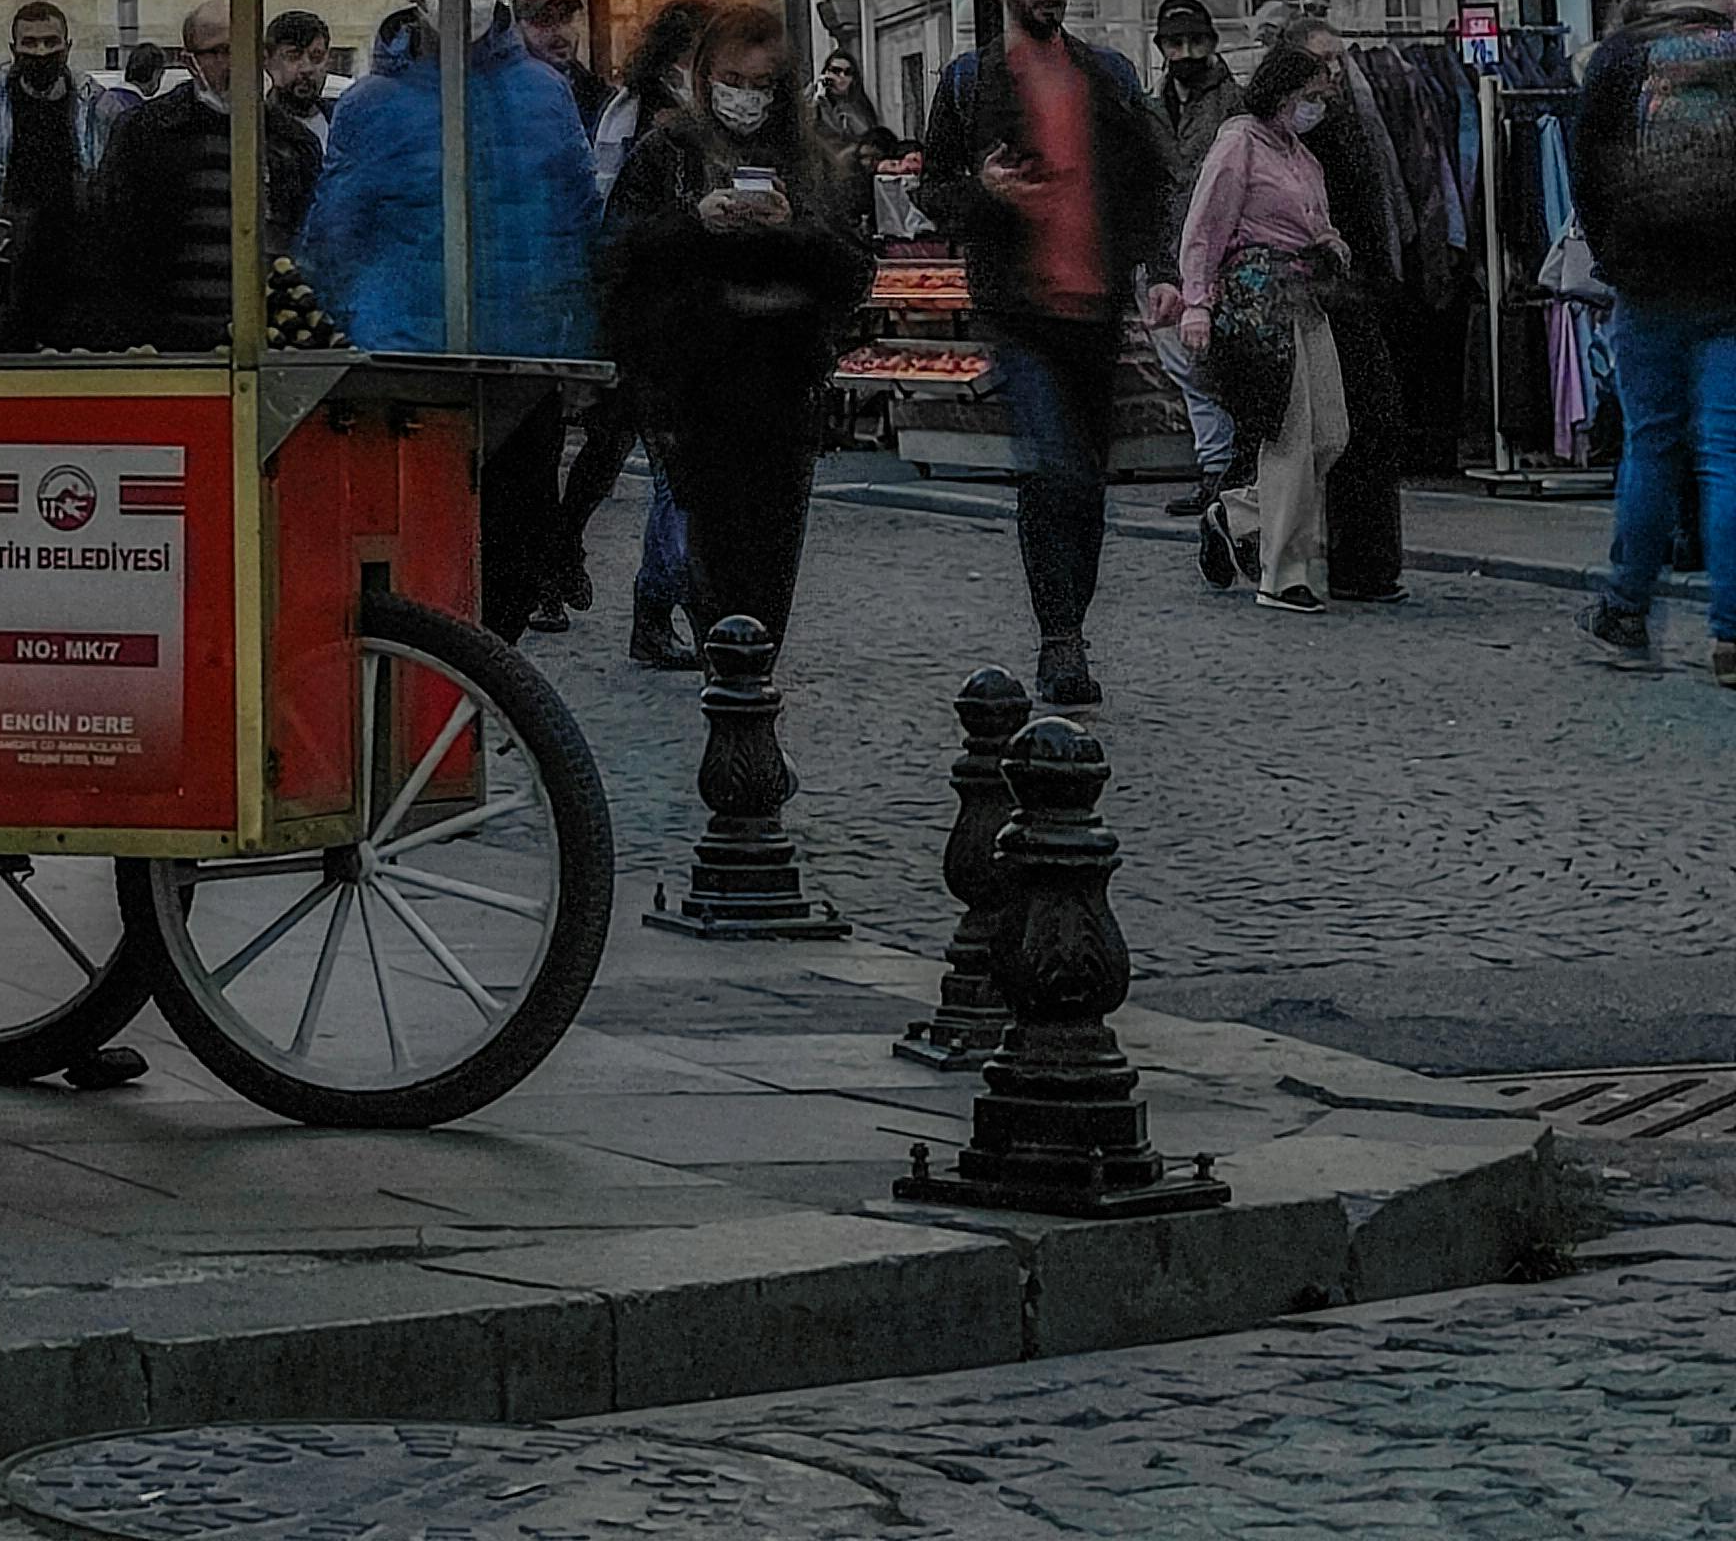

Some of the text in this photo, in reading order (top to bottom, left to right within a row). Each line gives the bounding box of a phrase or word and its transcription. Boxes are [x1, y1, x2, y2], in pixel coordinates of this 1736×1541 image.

[37, 542, 170, 571] BELEDİYESİ
[0, 710, 135, 735] ENGİN DERE
